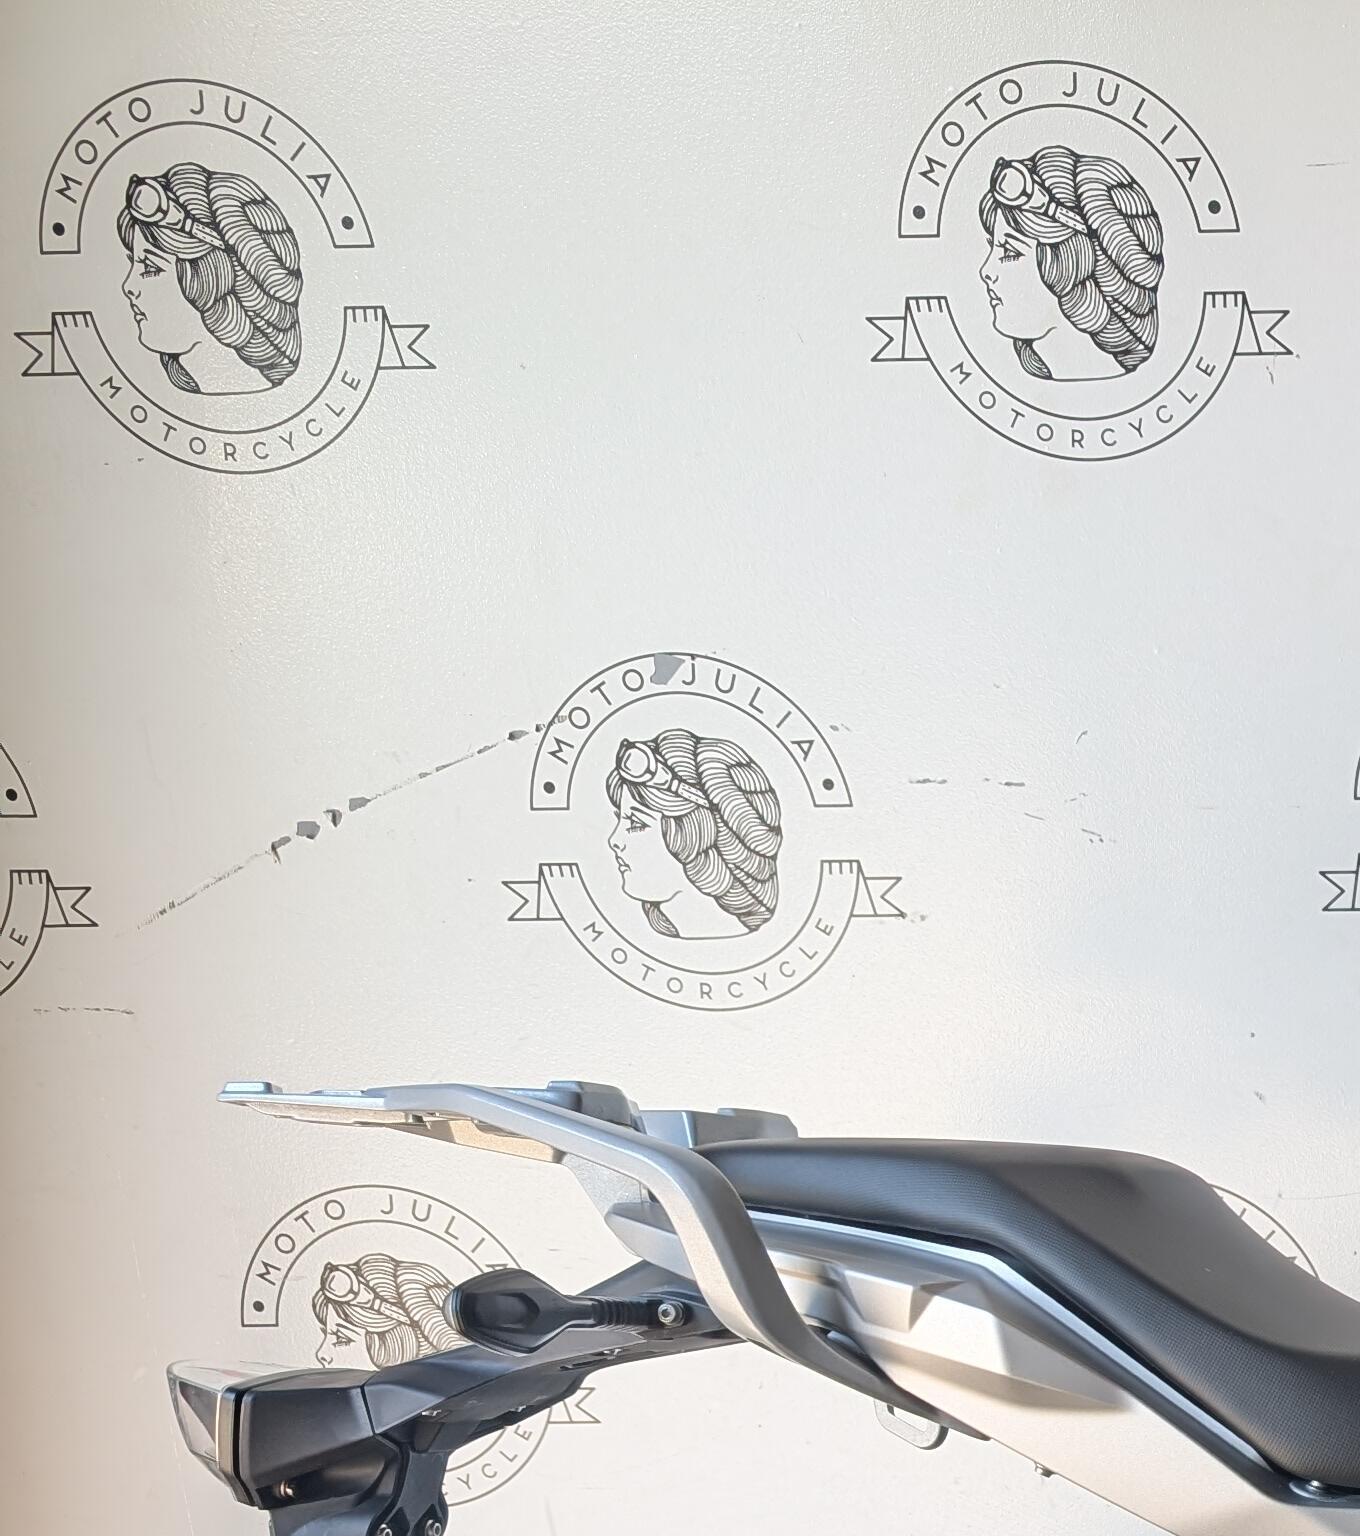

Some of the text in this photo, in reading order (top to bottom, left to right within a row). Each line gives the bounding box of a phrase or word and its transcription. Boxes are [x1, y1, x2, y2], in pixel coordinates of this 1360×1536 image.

[55, 88, 331, 205] MOTO JULIA
[918, 72, 1201, 187] MOTO JULIA
[99, 369, 362, 463] MOTORCYCLE
[950, 356, 1215, 448] MOTORCYCLE
[547, 662, 814, 764] MOTO JULIA
[583, 918, 834, 1000] MOTORCYCLE
[256, 1199, 345, 1286] MOTO
